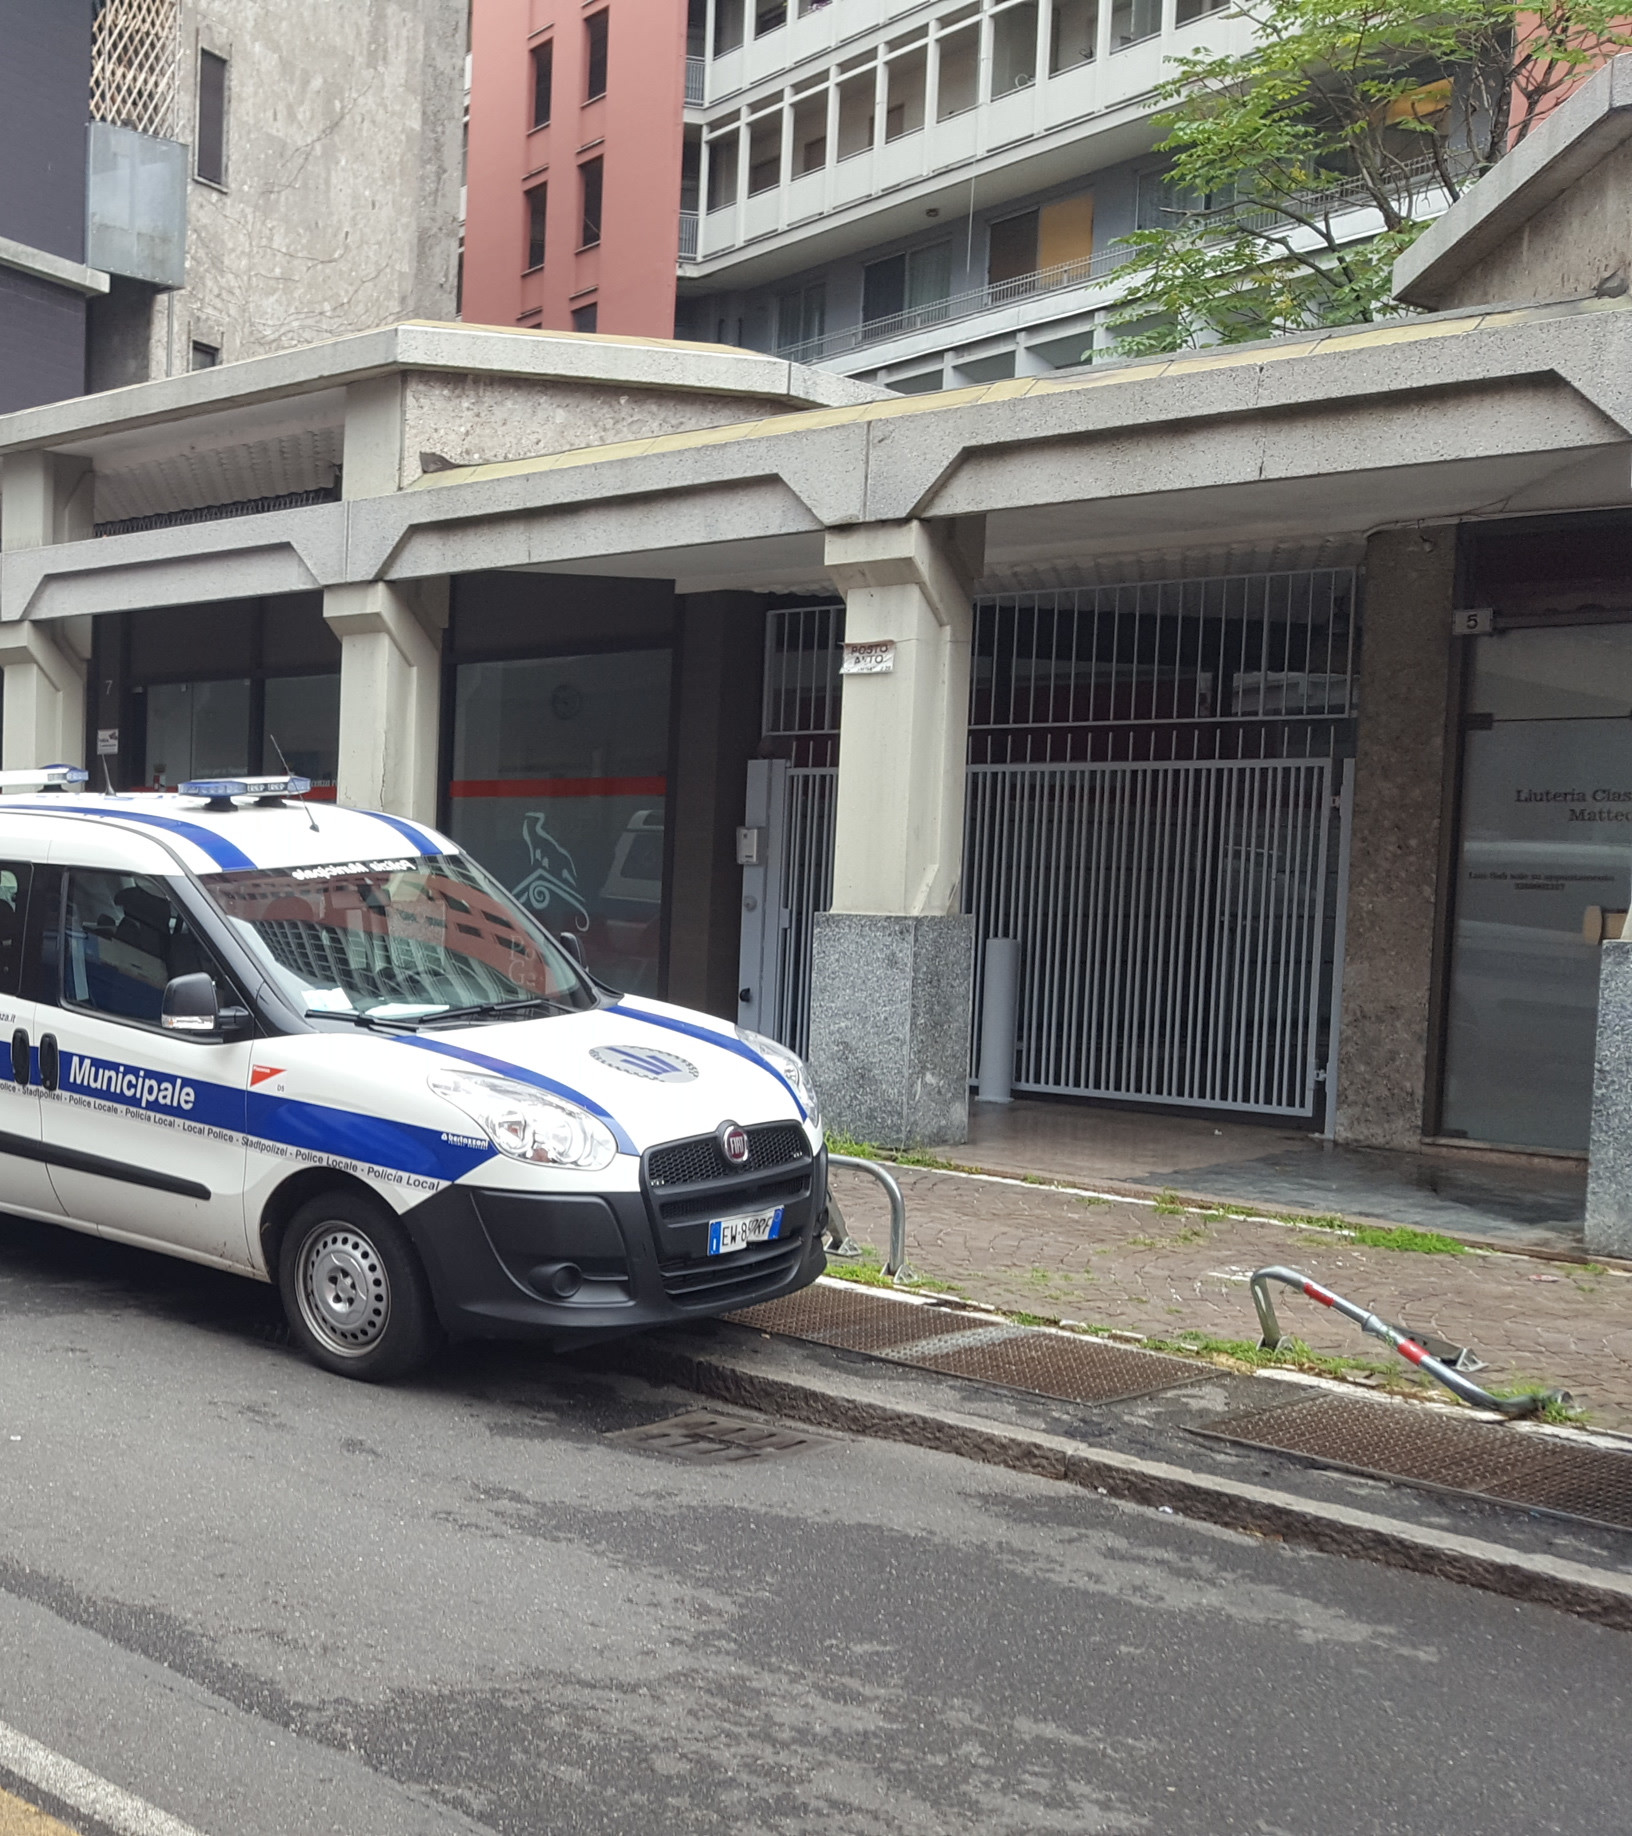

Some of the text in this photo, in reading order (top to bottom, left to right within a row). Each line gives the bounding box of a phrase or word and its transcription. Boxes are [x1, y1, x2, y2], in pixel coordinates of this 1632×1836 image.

[1467, 614, 1478, 630] 5
[851, 644, 888, 655] POSTO
[105, 680, 113, 695] 7
[1516, 788, 1586, 803] Liuteria
[69, 1055, 196, 1111] Municipale
[68, 1094, 92, 1108] Police
[93, 1100, 119, 1114] Locale
[153, 1115, 176, 1129] Local
[182, 1121, 205, 1136] Local
[207, 1127, 234, 1143] Police
[295, 1149, 324, 1164] Police
[326, 1155, 358, 1173] Locale
[406, 1177, 441, 1192] Local
[730, 1136, 744, 1155] FIAT
